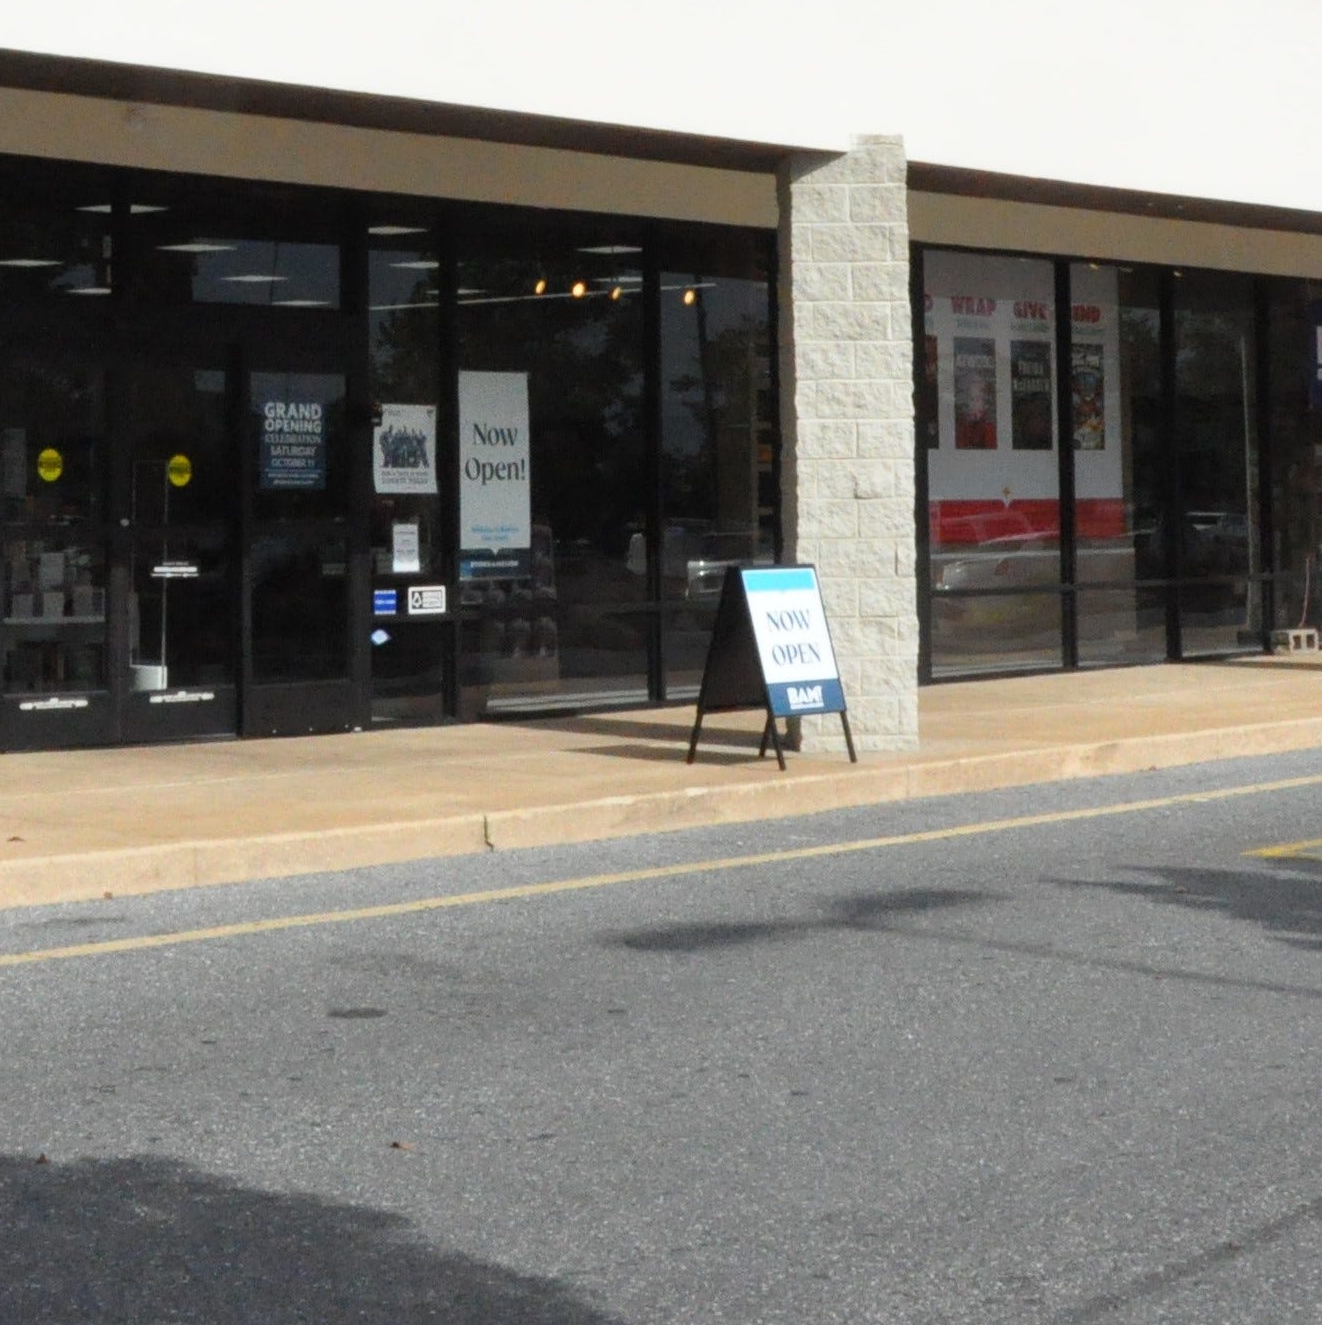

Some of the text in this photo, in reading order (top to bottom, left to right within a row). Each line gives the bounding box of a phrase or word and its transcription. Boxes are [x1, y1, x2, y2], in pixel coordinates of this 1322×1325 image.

[264, 402, 322, 420] GRAND
[264, 419, 323, 433] OPENING
[473, 423, 518, 446] Now
[465, 456, 526, 485] Open!
[765, 608, 810, 632] NOW
[771, 641, 822, 666] OPEN
